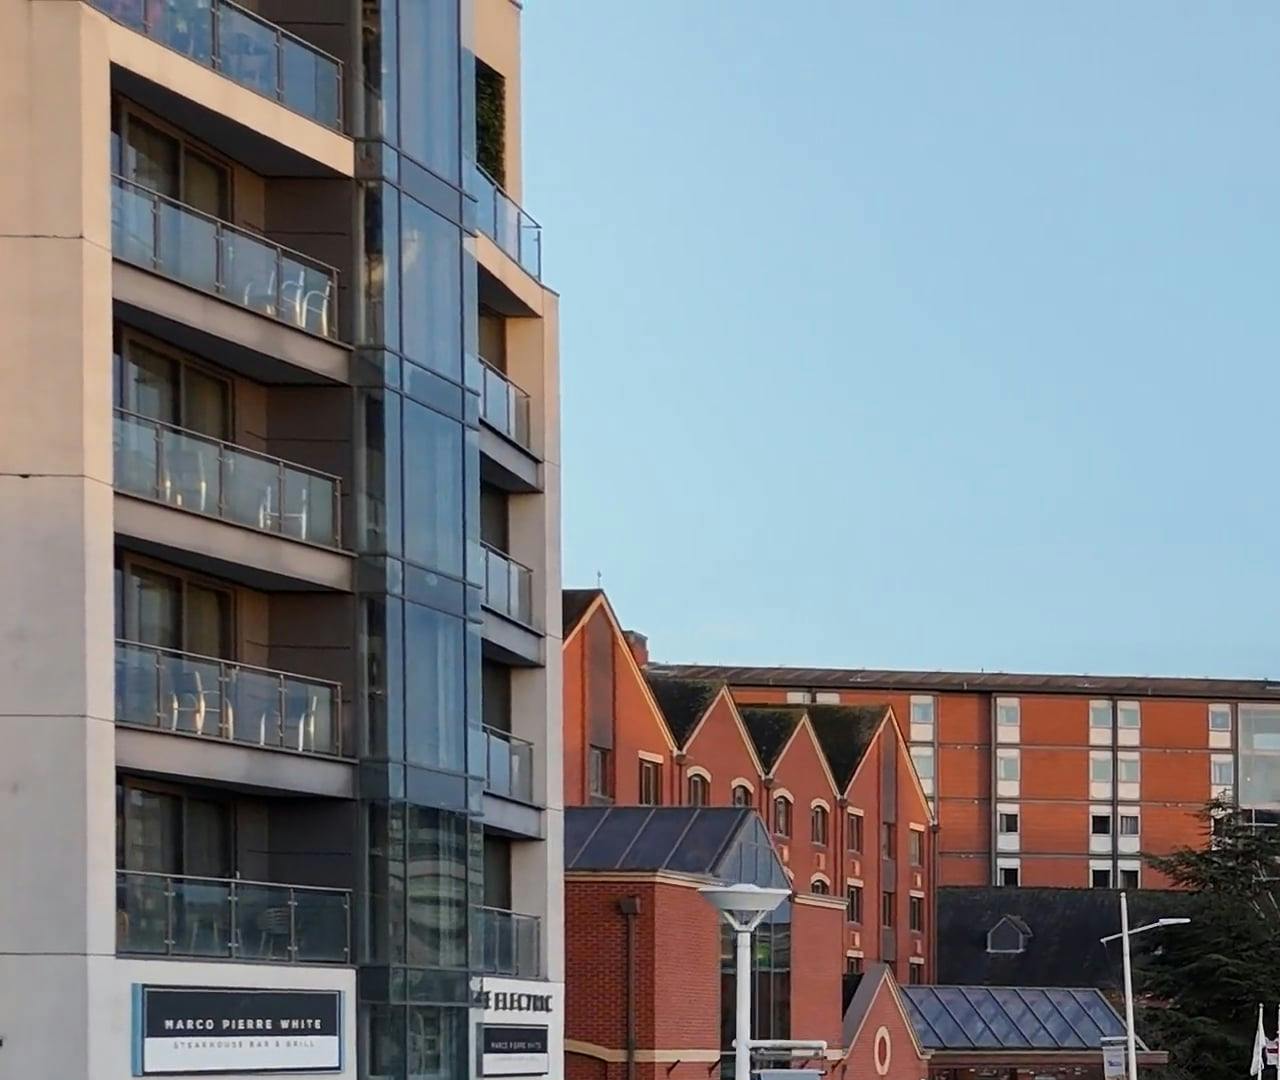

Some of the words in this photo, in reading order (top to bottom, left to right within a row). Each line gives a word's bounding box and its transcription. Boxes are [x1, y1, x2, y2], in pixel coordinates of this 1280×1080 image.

[164, 1019, 215, 1030] MARCO
[222, 1019, 273, 1030] PIERRE
[280, 1019, 322, 1030] WHITE
